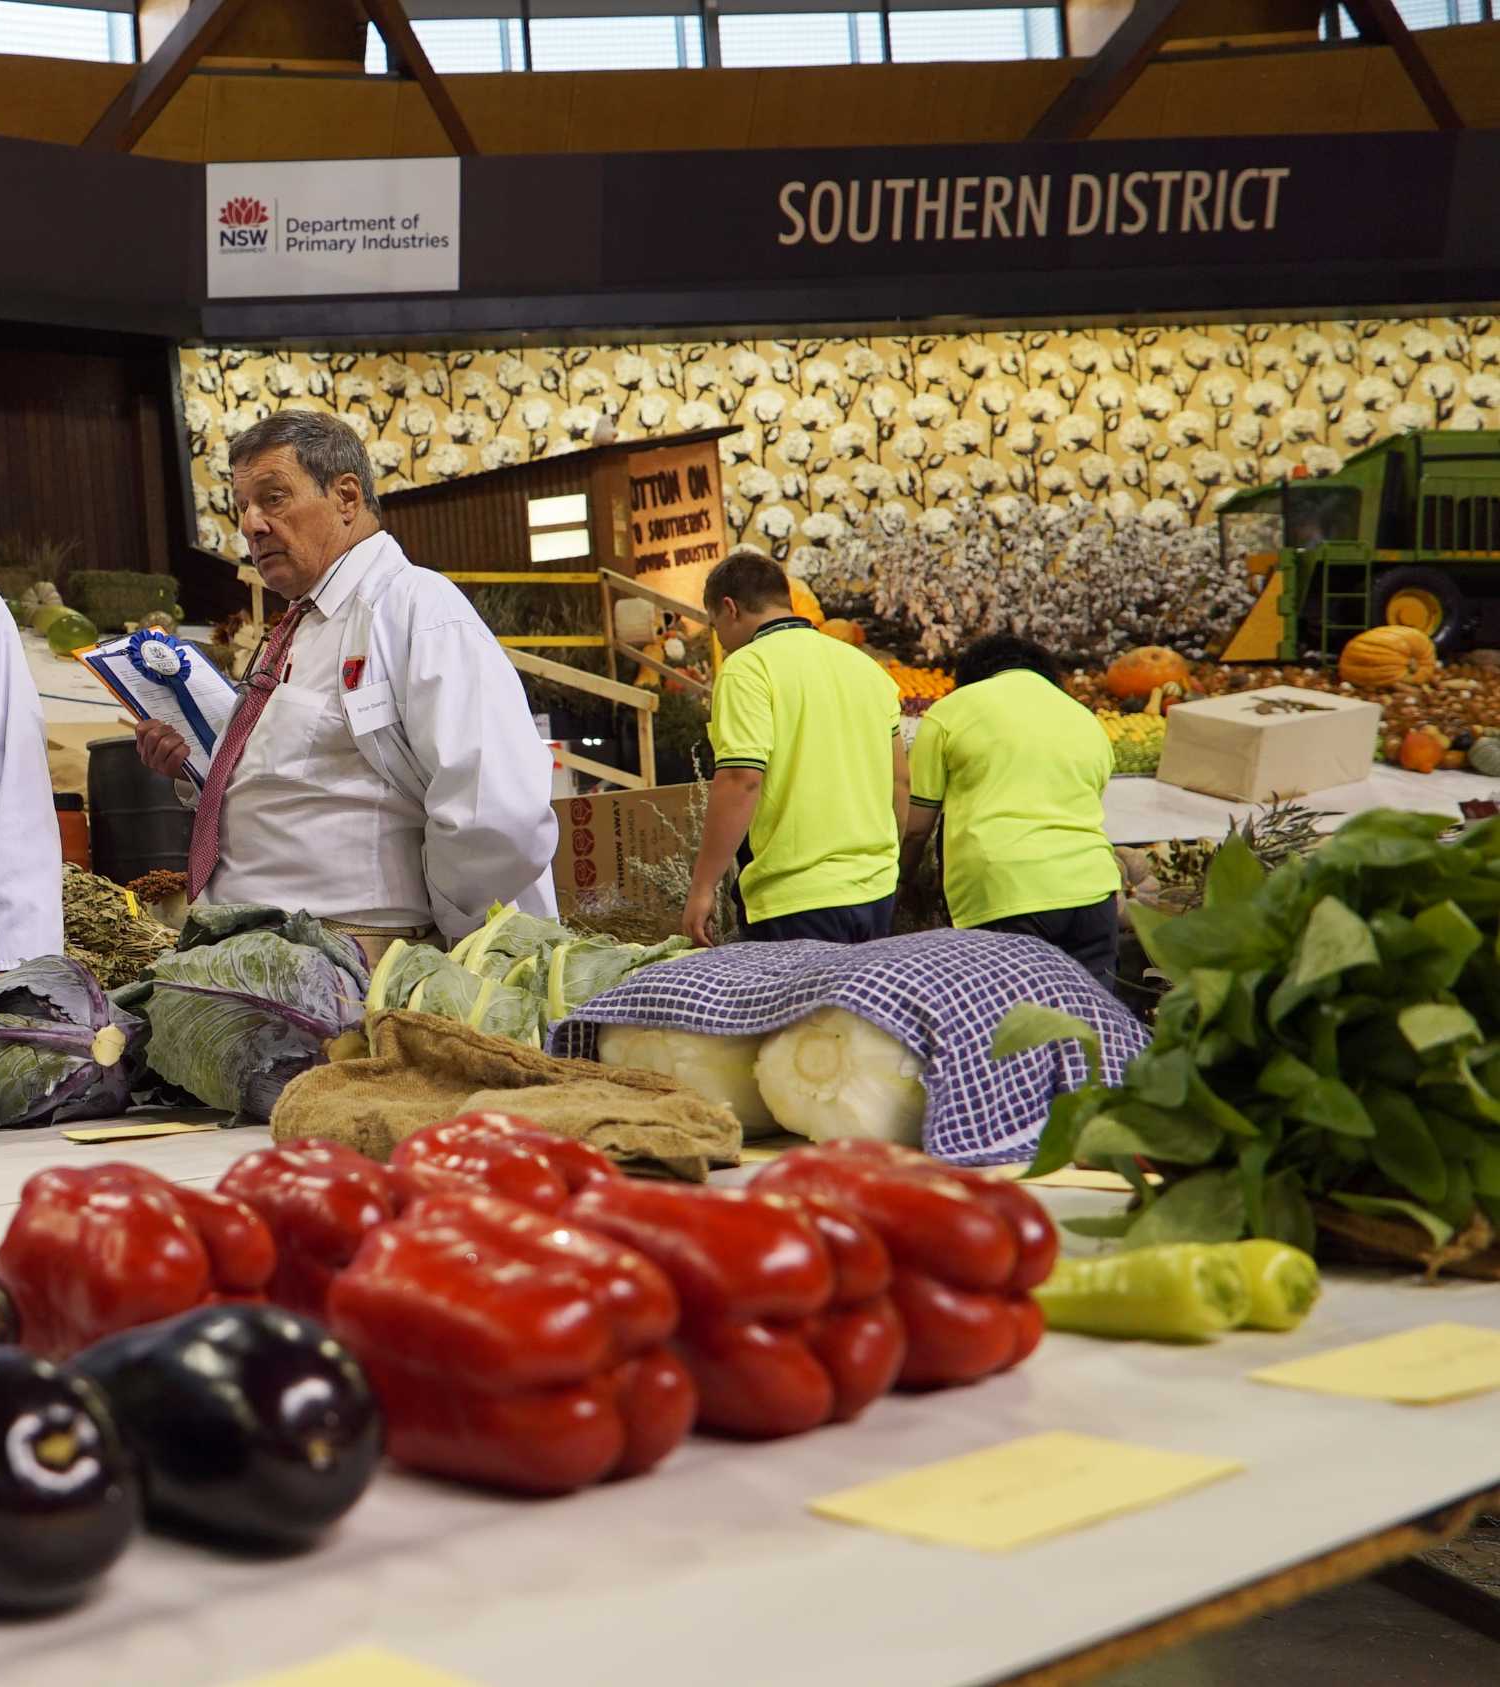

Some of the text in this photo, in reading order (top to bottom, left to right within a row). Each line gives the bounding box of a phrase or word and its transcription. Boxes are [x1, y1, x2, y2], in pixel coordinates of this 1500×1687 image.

[778, 167, 1291, 246] SOUTHERN DISTRICT
[286, 214, 420, 235] Department of
[220, 229, 268, 247] NSW
[286, 232, 449, 254] Primary Industries
[687, 464, 713, 501] ON
[674, 542, 720, 567] INDUSTRY
[612, 801, 625, 889] THROW AWAY
